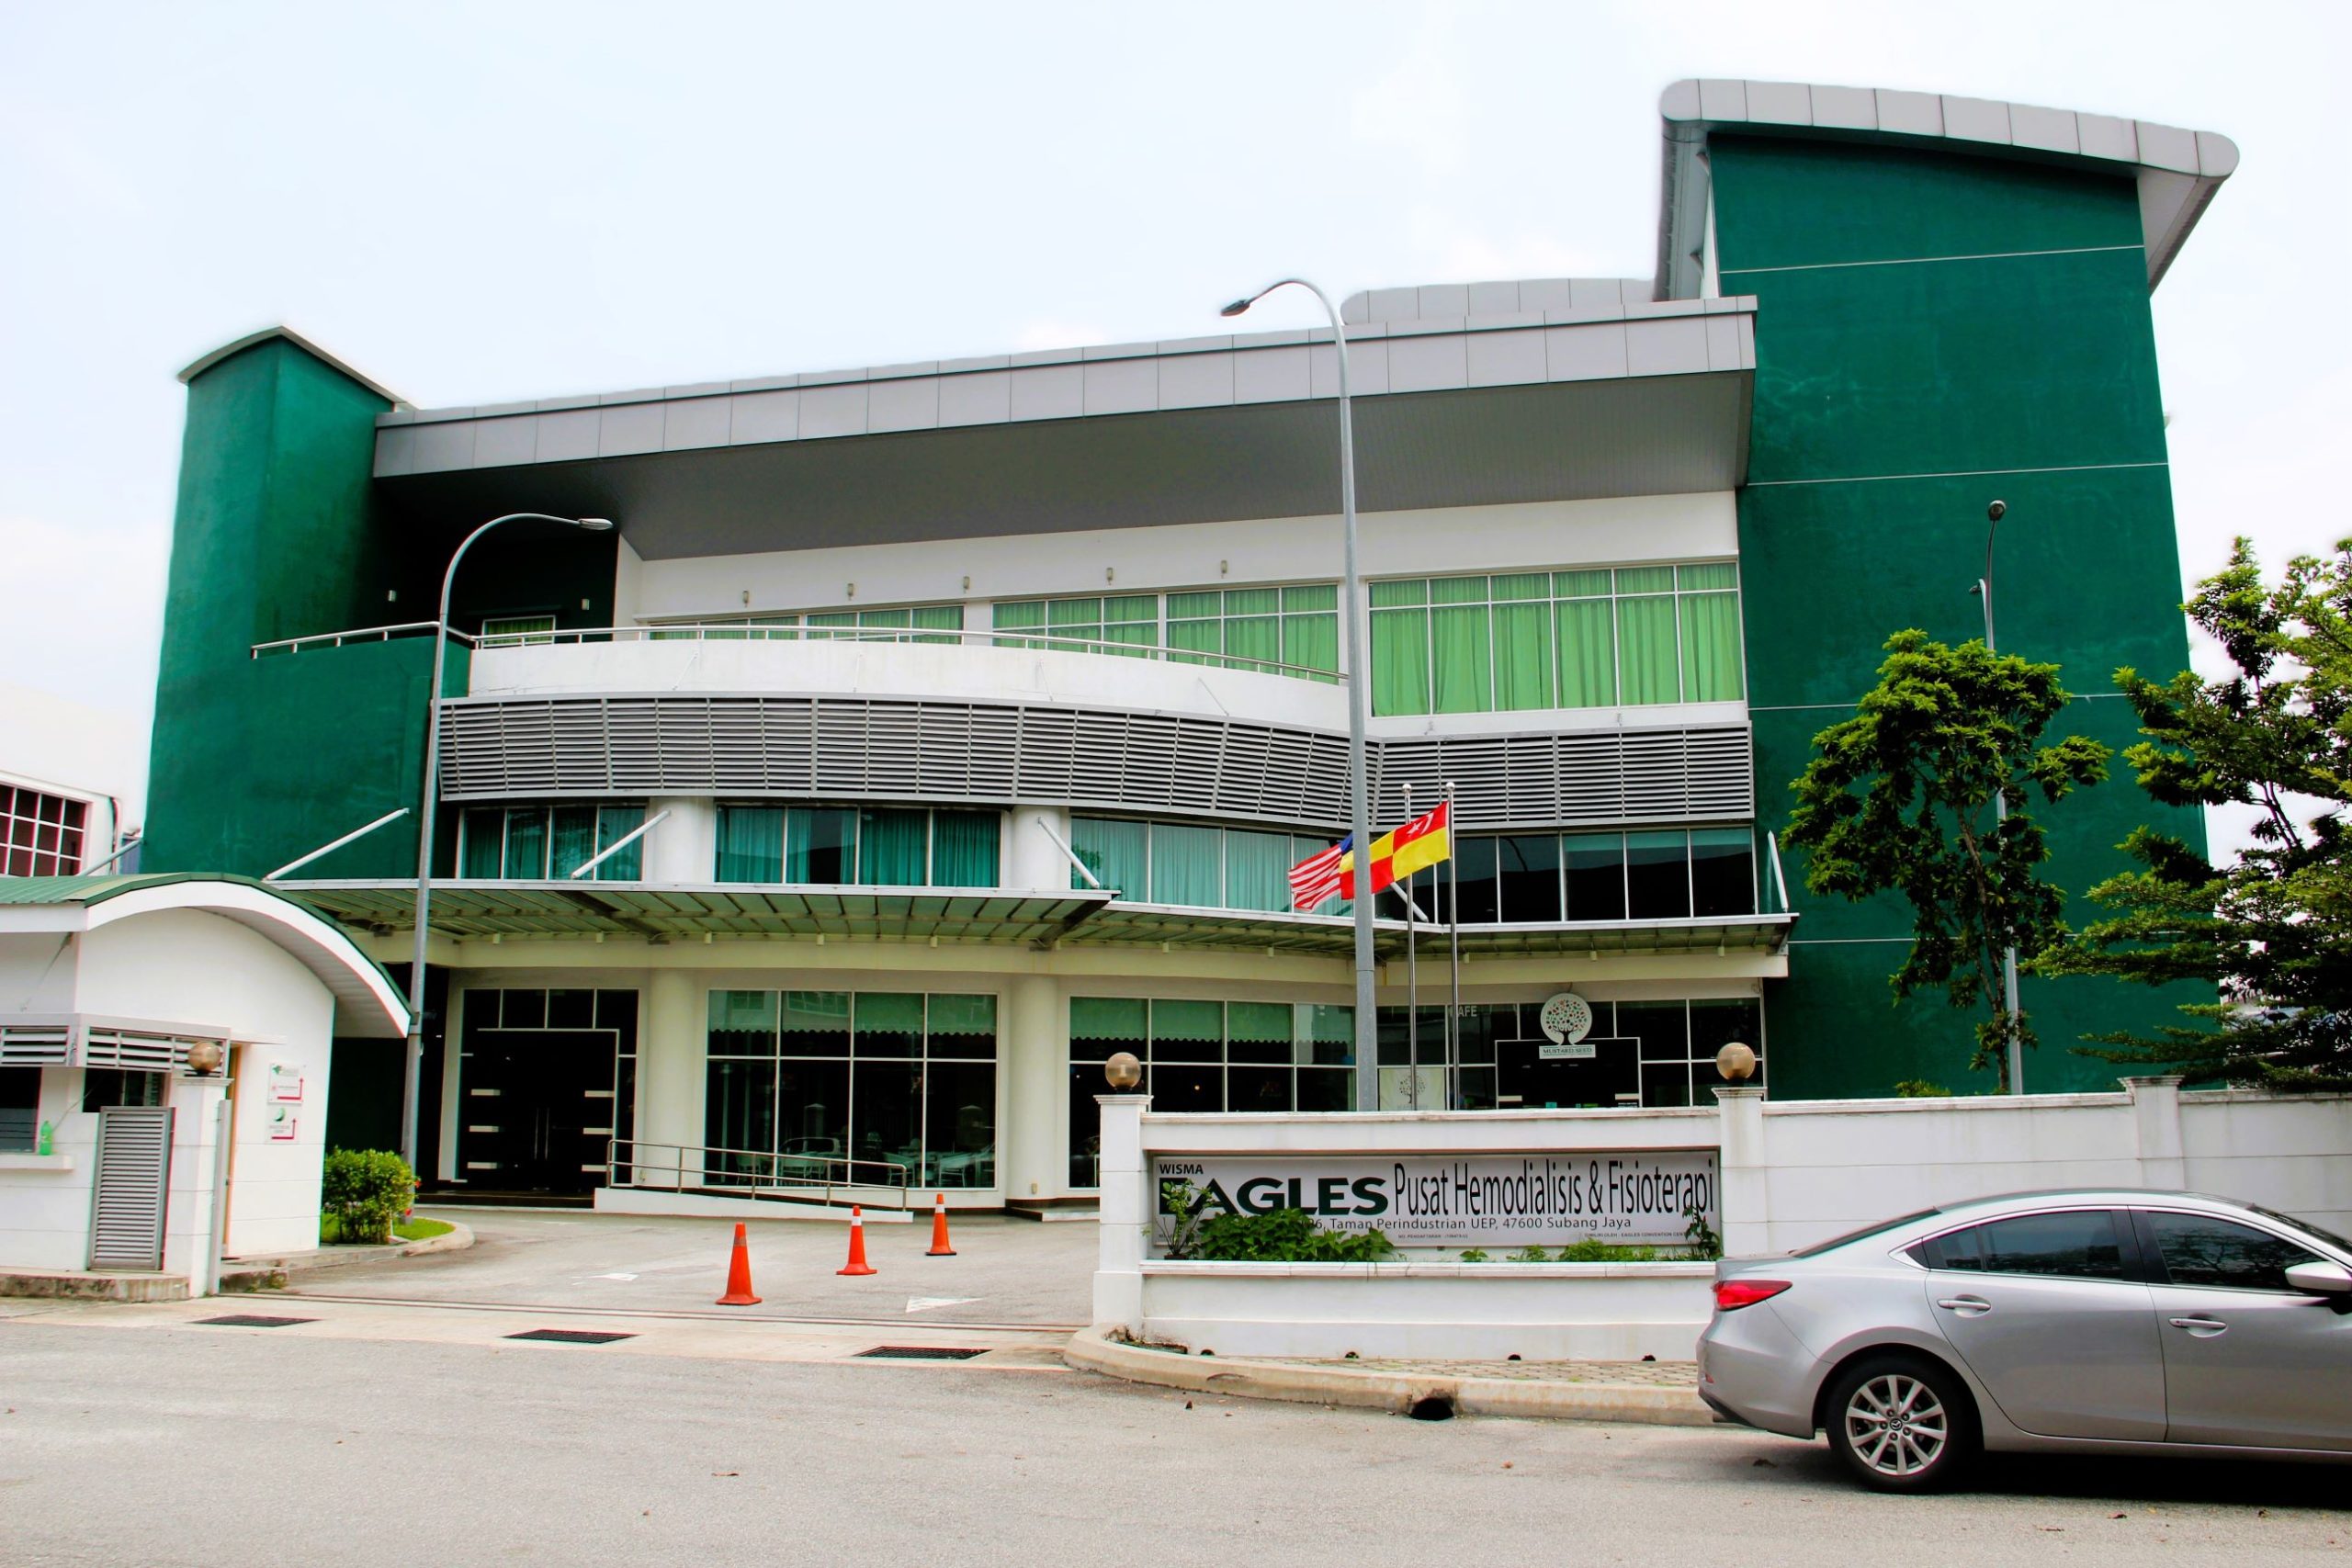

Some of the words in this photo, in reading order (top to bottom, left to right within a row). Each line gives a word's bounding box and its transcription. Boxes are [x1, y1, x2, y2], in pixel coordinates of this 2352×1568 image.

[1159, 1163, 1204, 1175] WISMA
[1159, 1177, 1389, 1216] EAGLES
[1394, 1162, 1449, 1216] Pusat
[1454, 1158, 1582, 1215] Hemodialisis
[1589, 1159, 1603, 1214] &
[1608, 1157, 1713, 1224] Fisioterapi
[1329, 1217, 1373, 1230] Taman
[1376, 1217, 1465, 1230] Perindustrian
[1471, 1217, 1498, 1231] UEP,
[1503, 1217, 1543, 1229] 47600
[1547, 1216, 1598, 1231] Subang
[1602, 1216, 1631, 1231] Jaya
